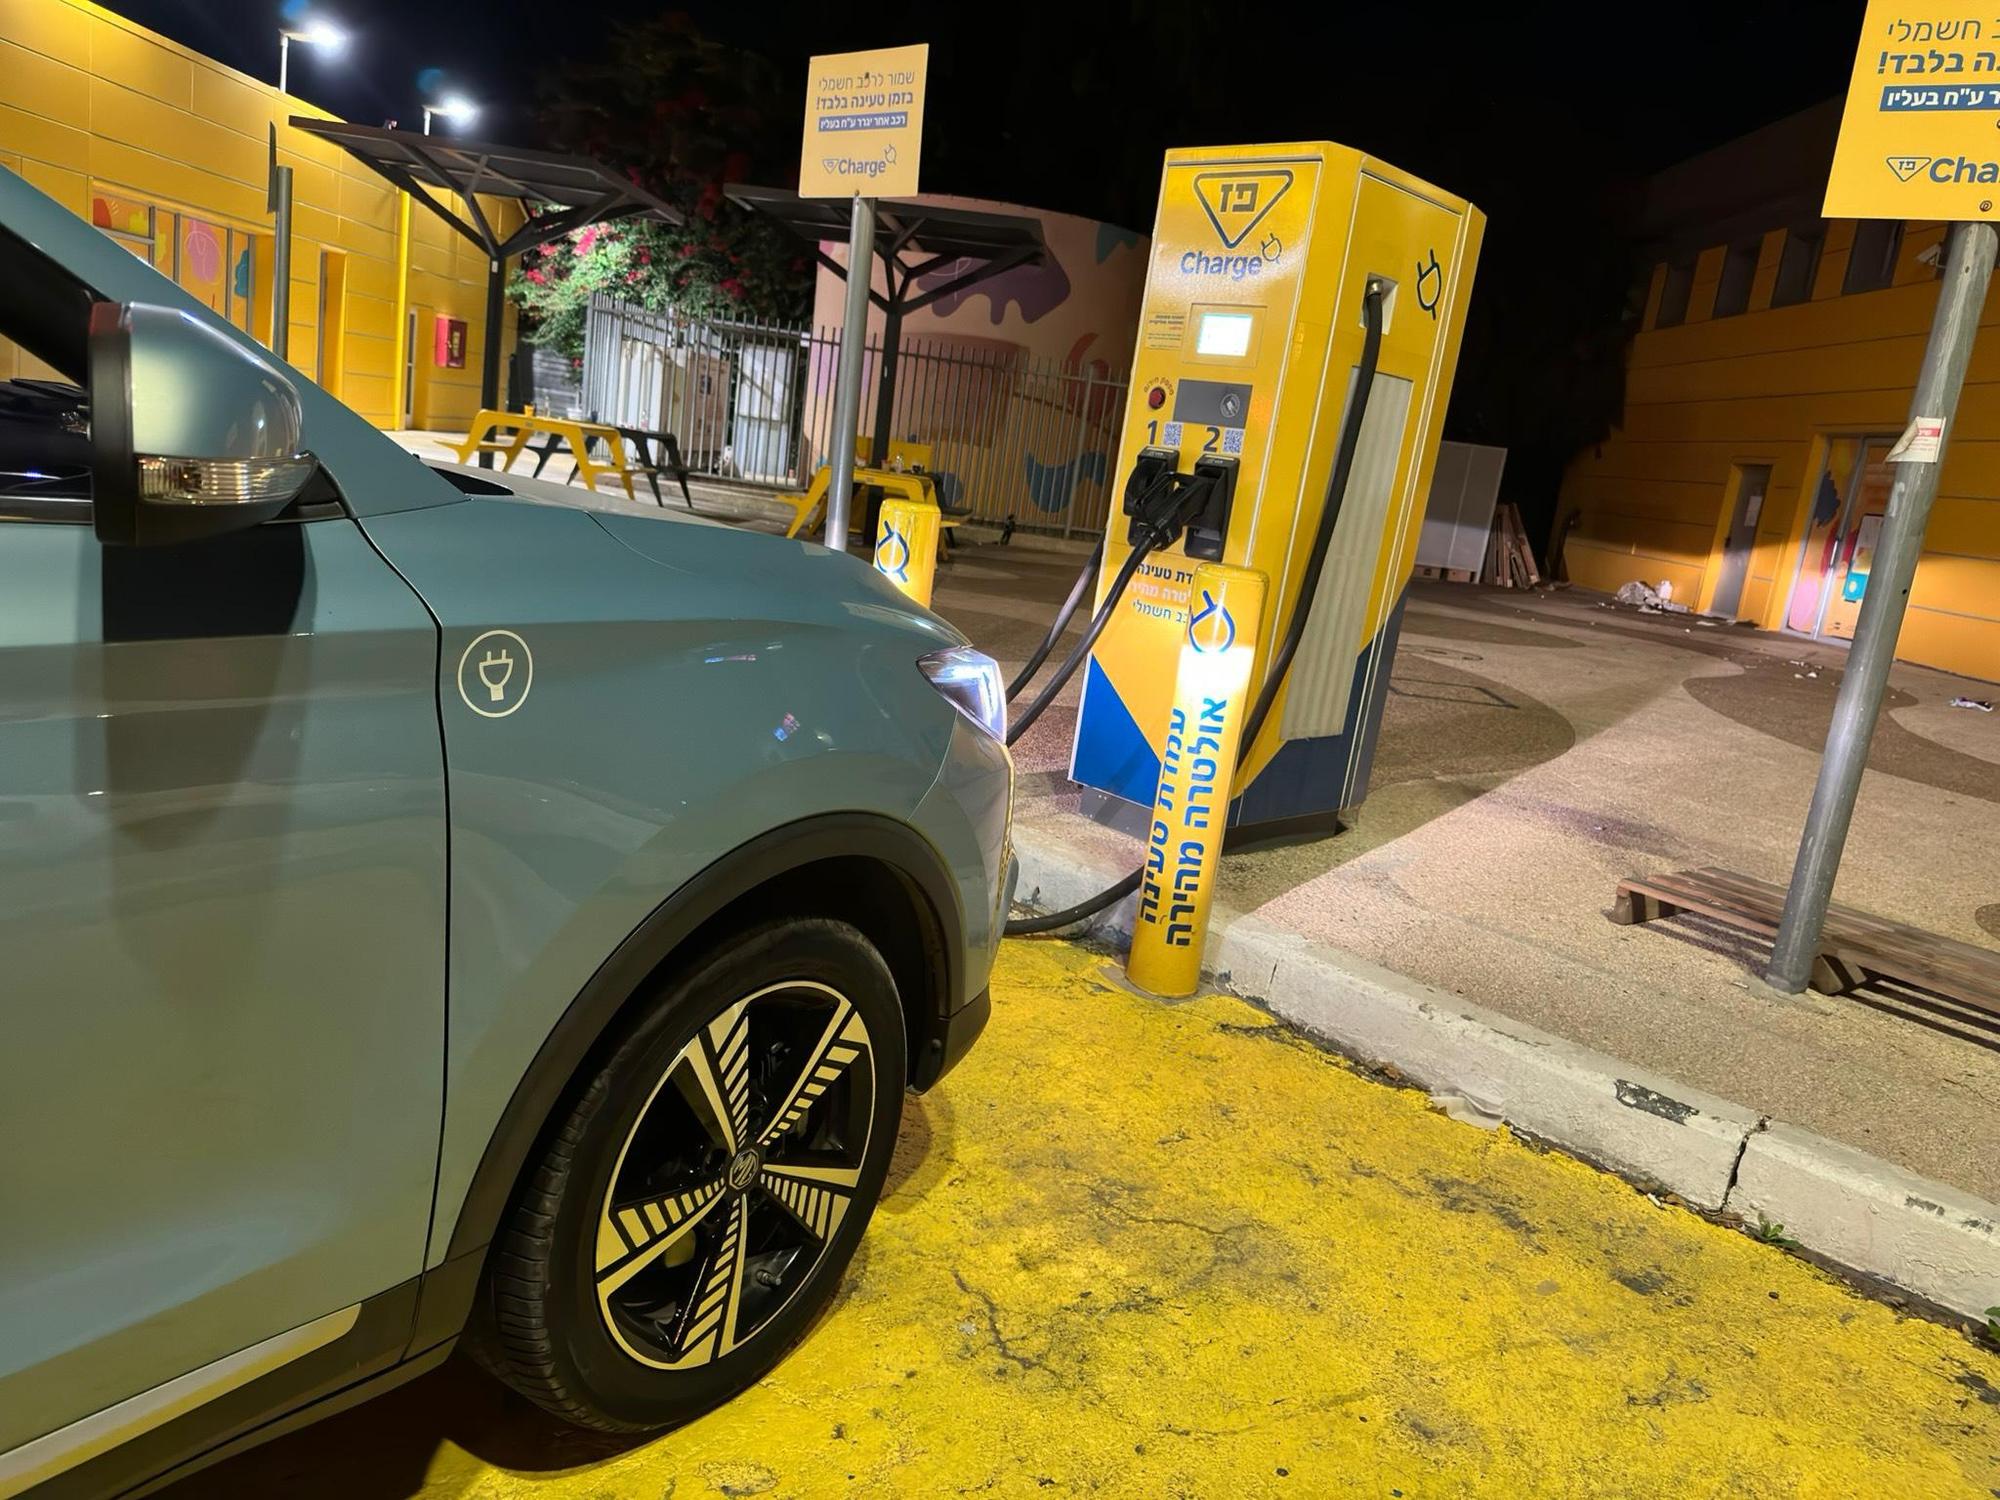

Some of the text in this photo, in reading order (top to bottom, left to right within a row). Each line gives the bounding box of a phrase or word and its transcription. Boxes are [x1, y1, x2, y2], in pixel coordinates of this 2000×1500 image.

[1887, 19, 1981, 42] חשמלי
[1877, 50, 1964, 74] בלבד!
[819, 77, 853, 92] חשמלי
[888, 71, 915, 87] שמור
[816, 92, 913, 110] בזמן טעינה בלבד!
[1887, 89, 1939, 107] בעליו
[838, 157, 887, 178] Charge
[1929, 157, 2000, 184] Cha
[1220, 183, 1259, 212] פז
[1180, 251, 1263, 281] Charge
[1147, 420, 1158, 445] 1
[1203, 426, 1221, 453] 2
[1137, 563, 1172, 580] טעינה
[1133, 598, 1172, 620] חשמלי
[1140, 708, 1186, 924] עמדת טעינה
[1166, 697, 1228, 947] אולטרה מהירה
